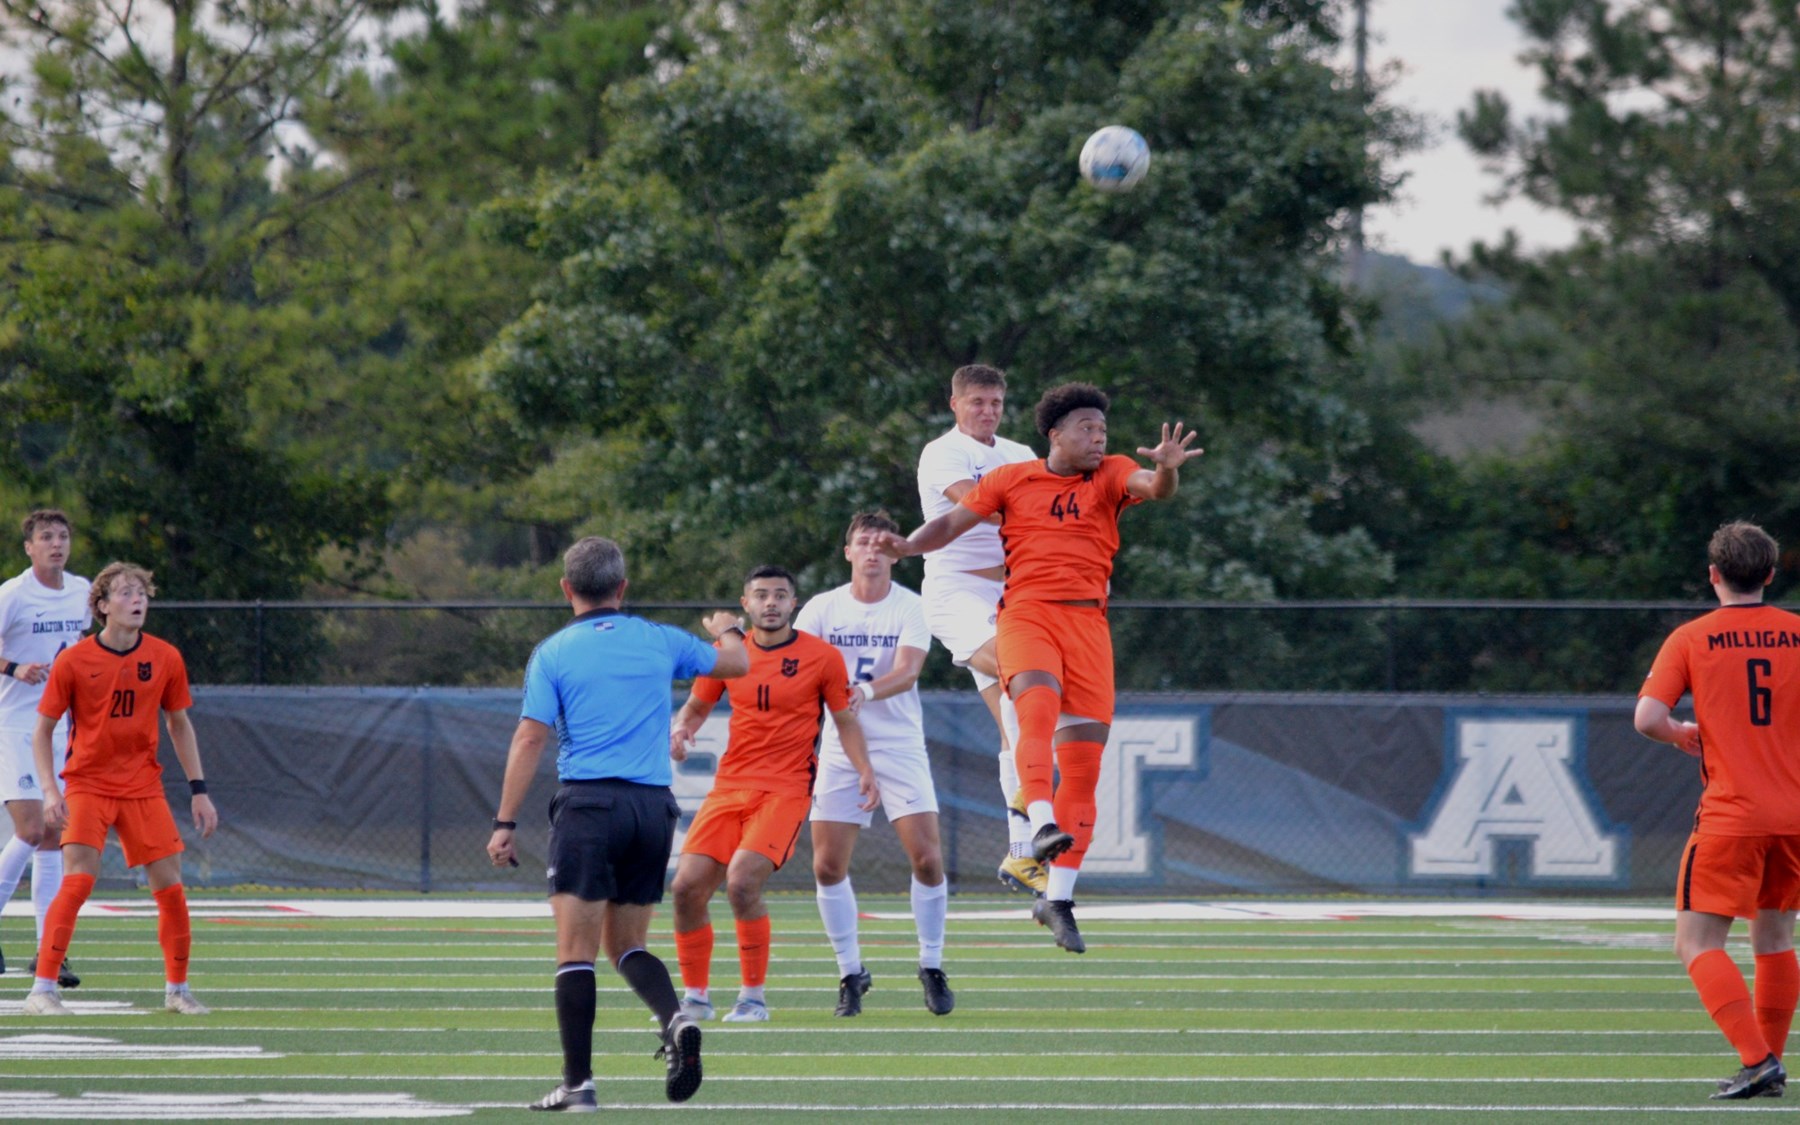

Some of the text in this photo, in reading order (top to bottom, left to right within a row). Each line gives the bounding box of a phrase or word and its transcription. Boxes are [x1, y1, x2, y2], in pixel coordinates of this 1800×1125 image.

[1050, 492, 1080, 522] 44
[32, 619, 84, 634] DALTON STAT
[829, 634, 869, 647] DALTON
[854, 656, 876, 686] 5
[110, 688, 135, 719] 20
[757, 683, 770, 712] 11
[1746, 657, 1772, 727] 6
